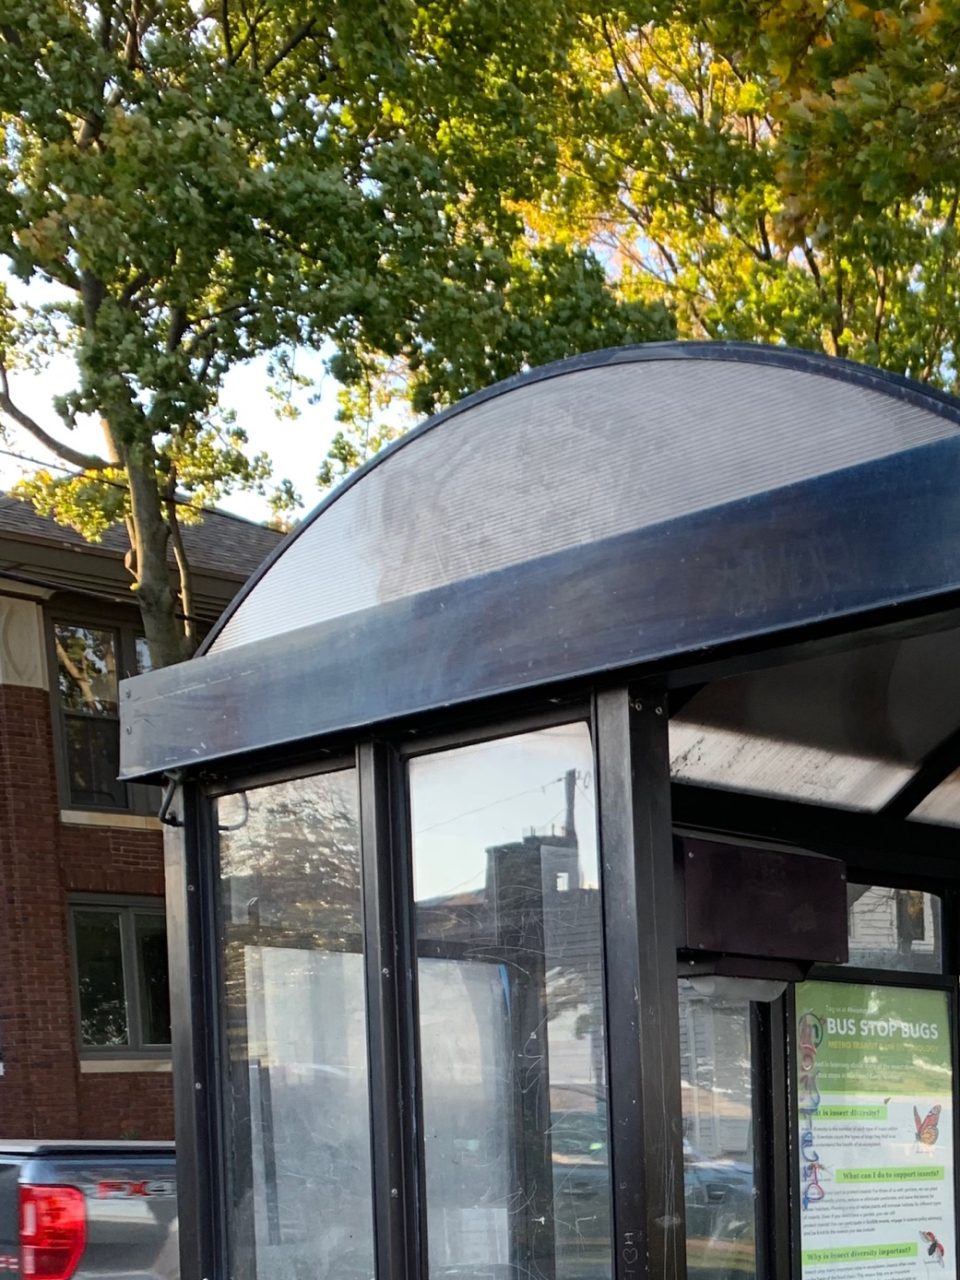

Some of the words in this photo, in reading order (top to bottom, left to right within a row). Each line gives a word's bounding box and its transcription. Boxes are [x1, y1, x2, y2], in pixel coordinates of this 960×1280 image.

[827, 1018, 856, 1035] BUS
[860, 1020, 898, 1037] STOP
[901, 1022, 939, 1039] BUGS
[843, 1171, 861, 1180] What
[862, 1172, 871, 1180] can
[877, 1171, 885, 1179] do
[893, 1170, 916, 1180] support
[917, 1169, 939, 1178] insects?
[96, 1180, 174, 1199] FX4
[807, 1253, 823, 1262] Why
[823, 1252, 830, 1260] is
[830, 1251, 850, 1260] insect
[850, 1249, 877, 1259] diversity
[878, 1246, 912, 1257] important?
